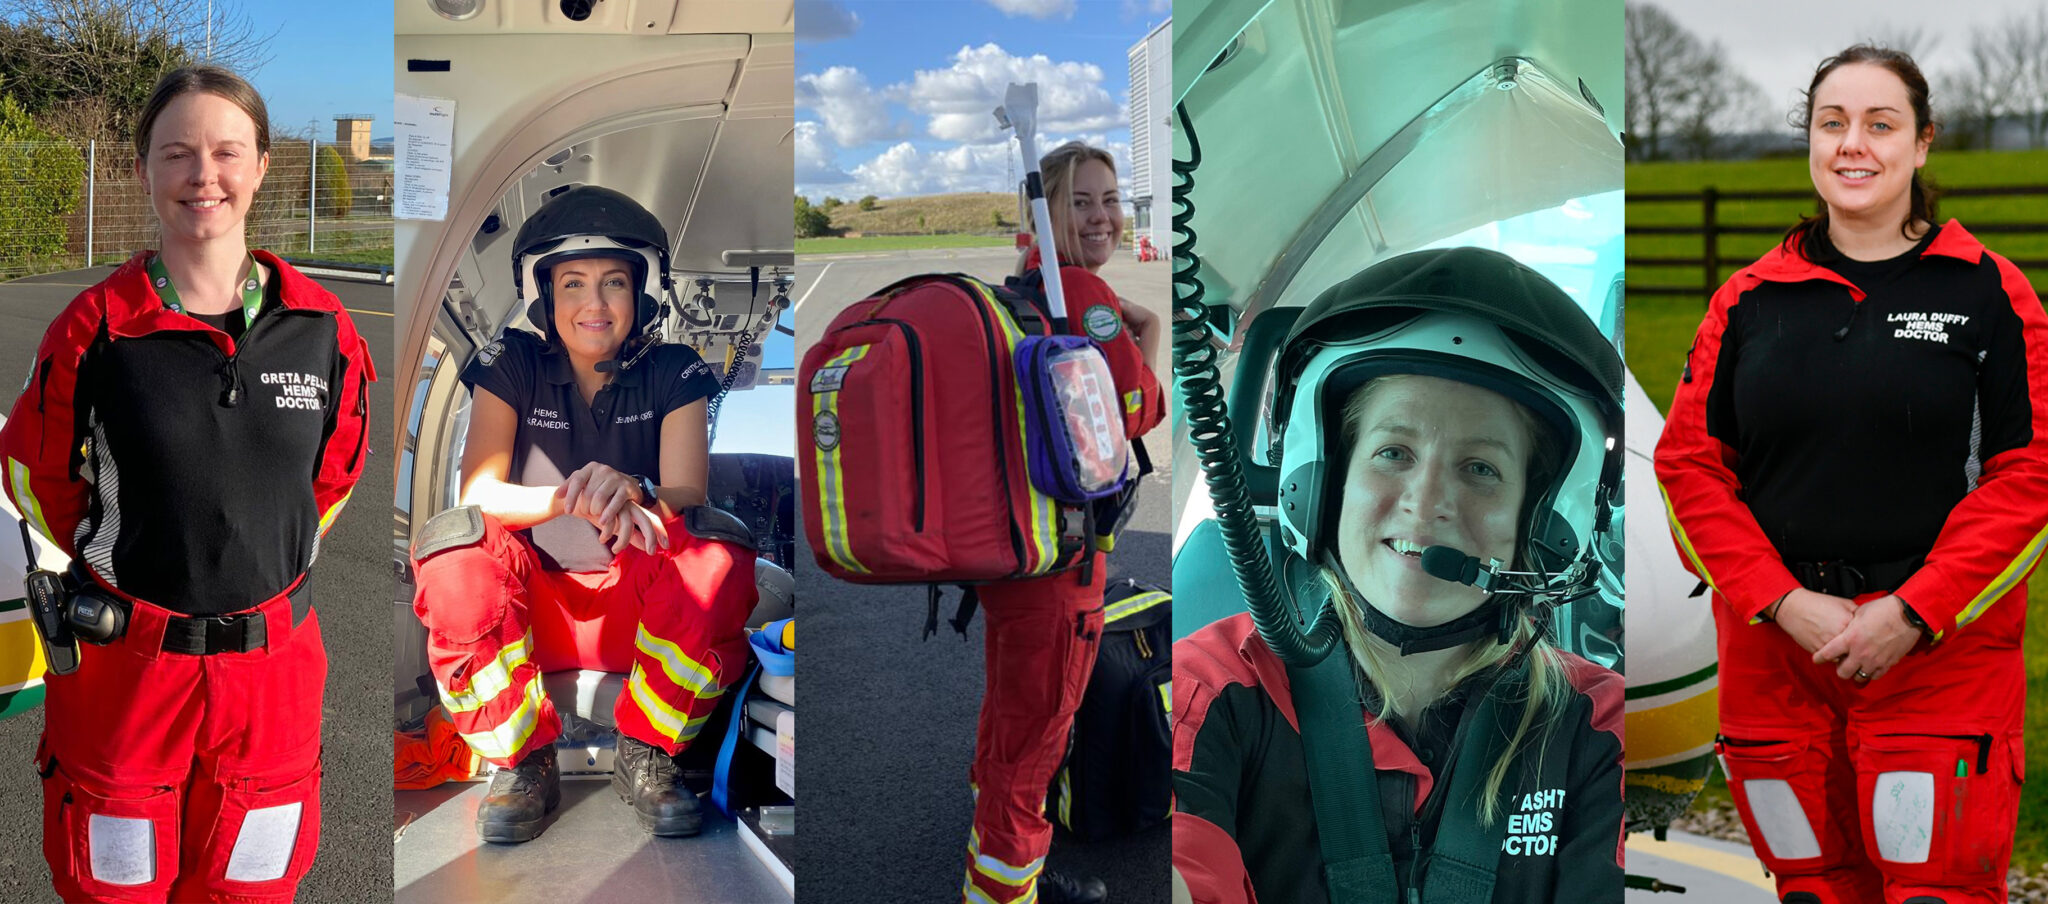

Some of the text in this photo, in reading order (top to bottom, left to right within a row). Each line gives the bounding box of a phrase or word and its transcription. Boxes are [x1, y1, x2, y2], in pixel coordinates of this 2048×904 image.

[1887, 312, 1970, 326] LAURA DUFFY
[1905, 320, 1945, 332] HEMS
[1893, 328, 1949, 344] DOCTOR
[260, 372, 301, 384] GRETA
[282, 384, 317, 398] HEMS
[275, 395, 321, 410] DOCTOR
[533, 407, 558, 419] HEMS
[526, 416, 570, 430] ARAMEDIC
[1507, 811, 1554, 834] EMS
